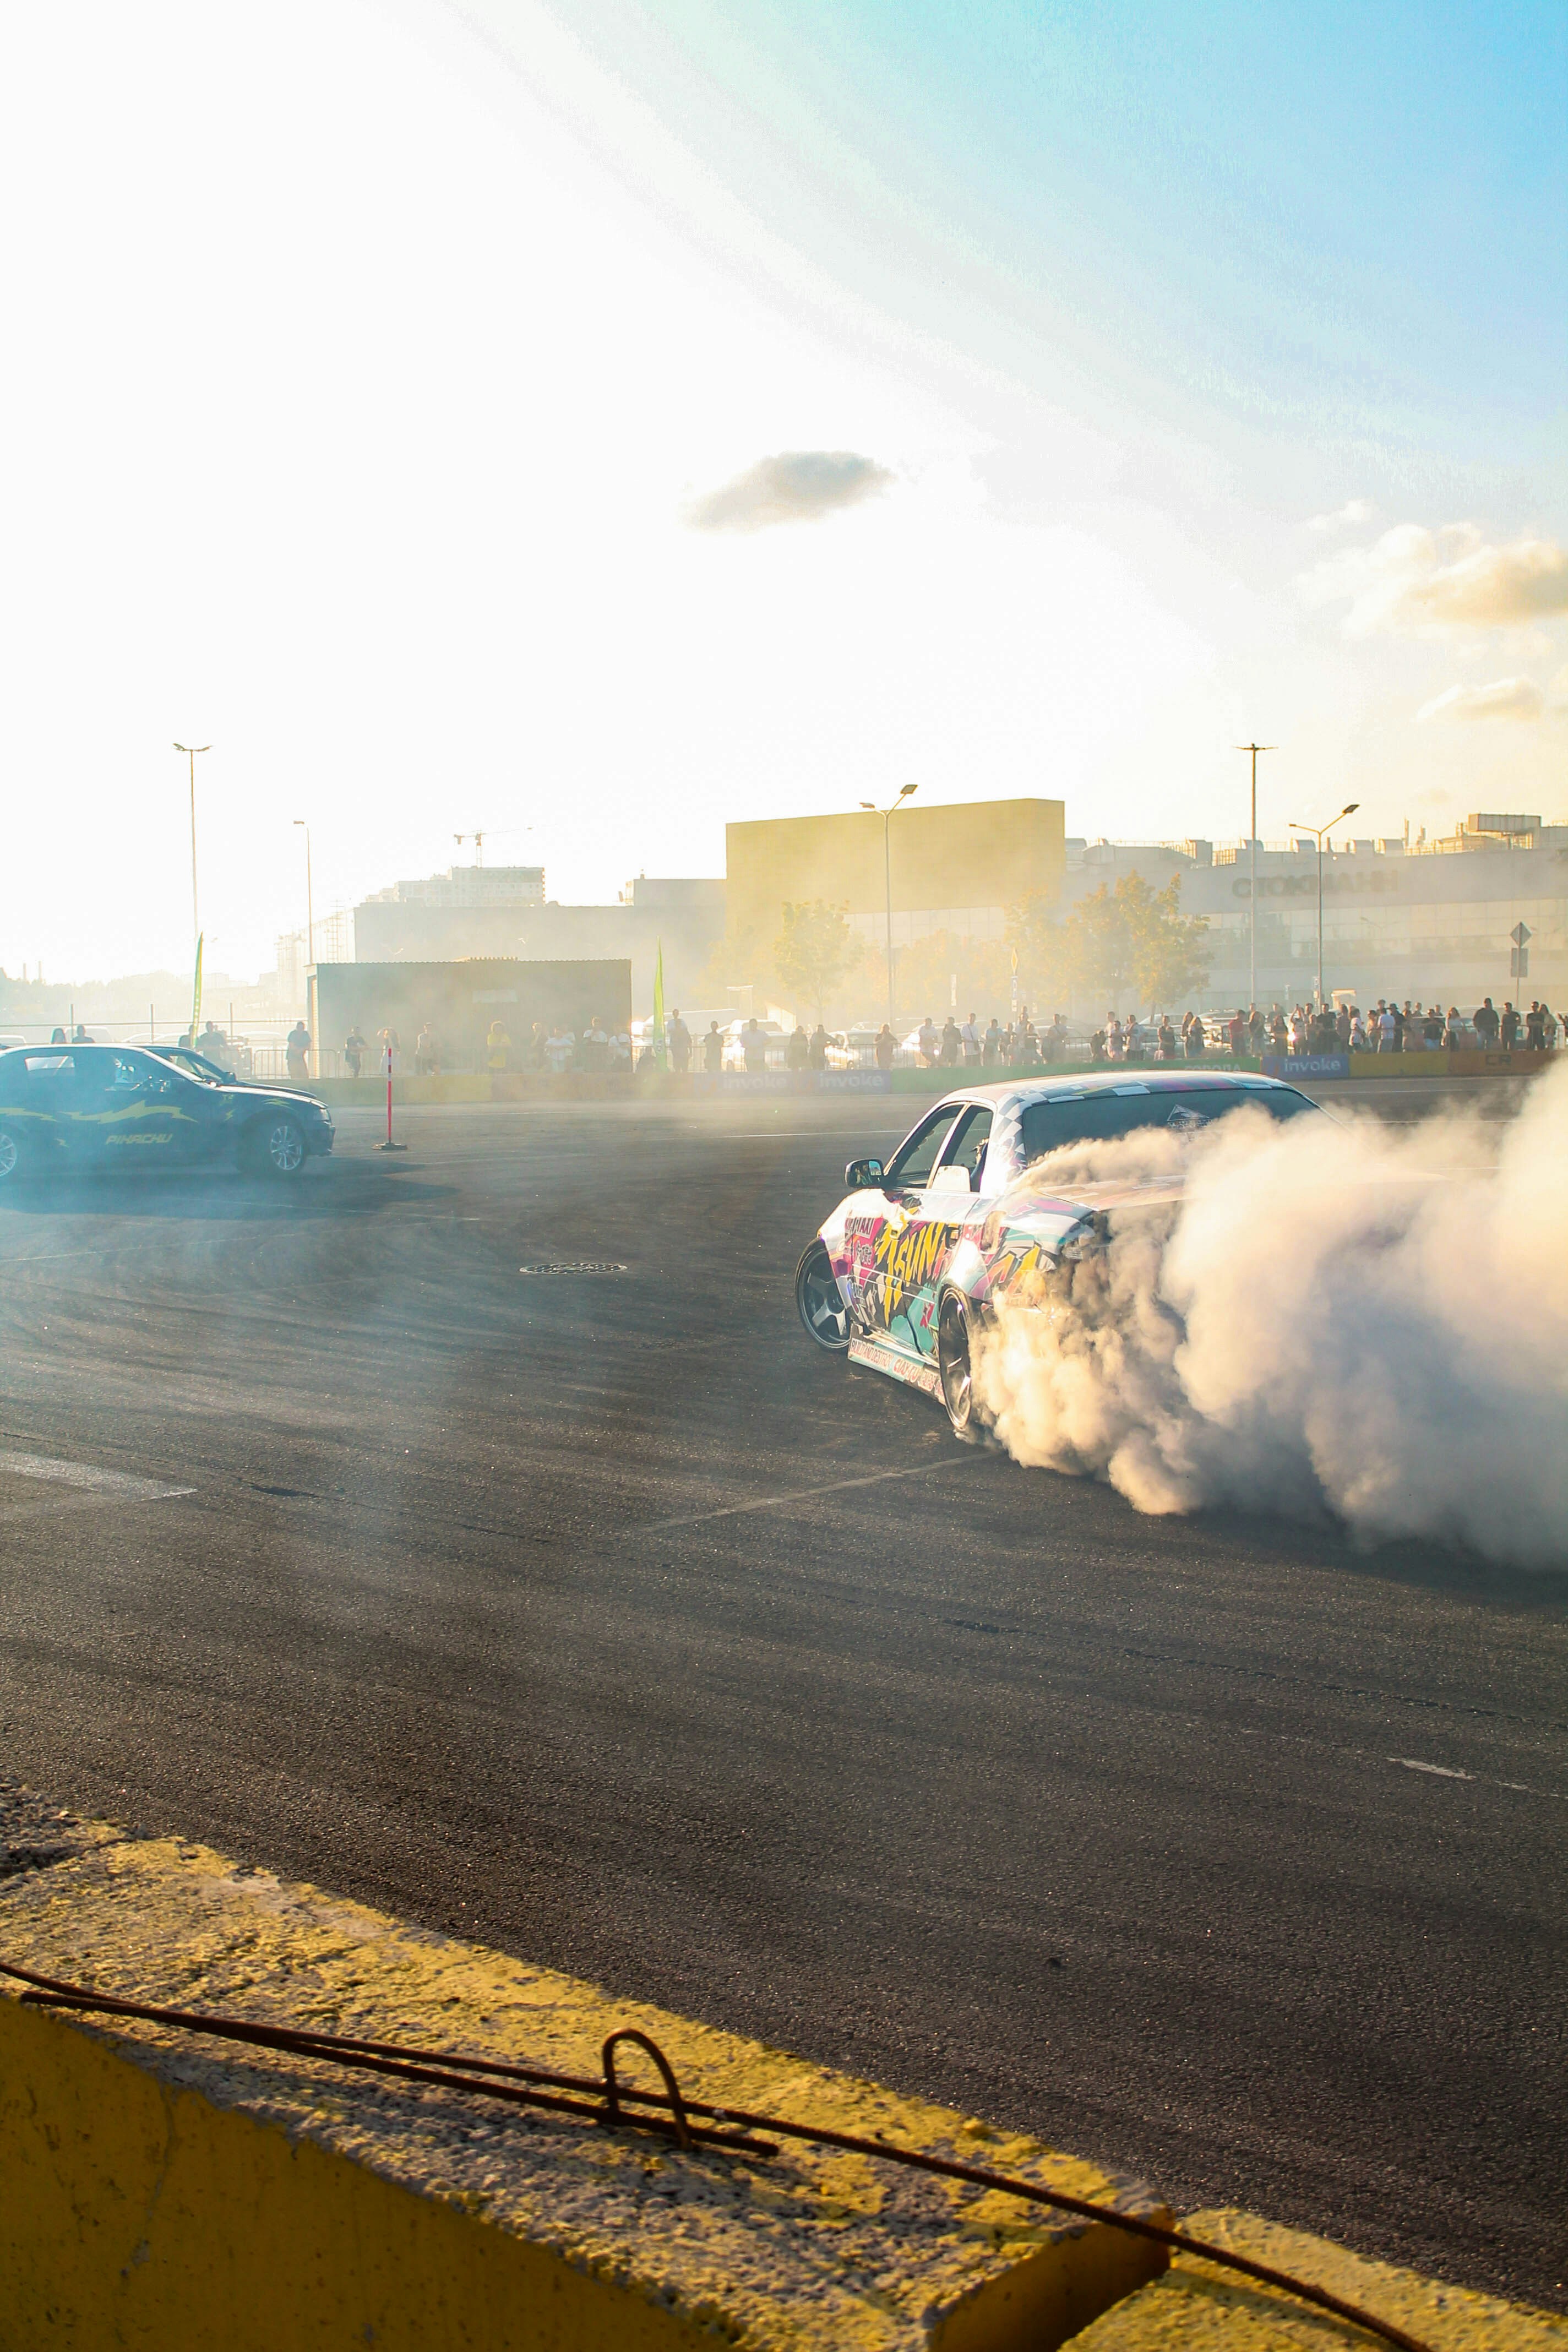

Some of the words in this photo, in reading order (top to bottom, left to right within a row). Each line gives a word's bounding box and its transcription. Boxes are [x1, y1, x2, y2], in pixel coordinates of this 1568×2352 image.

[1284, 1058, 1340, 1072] invoke
[723, 1074, 787, 1090] invoke
[819, 1072, 885, 1088] invoke
